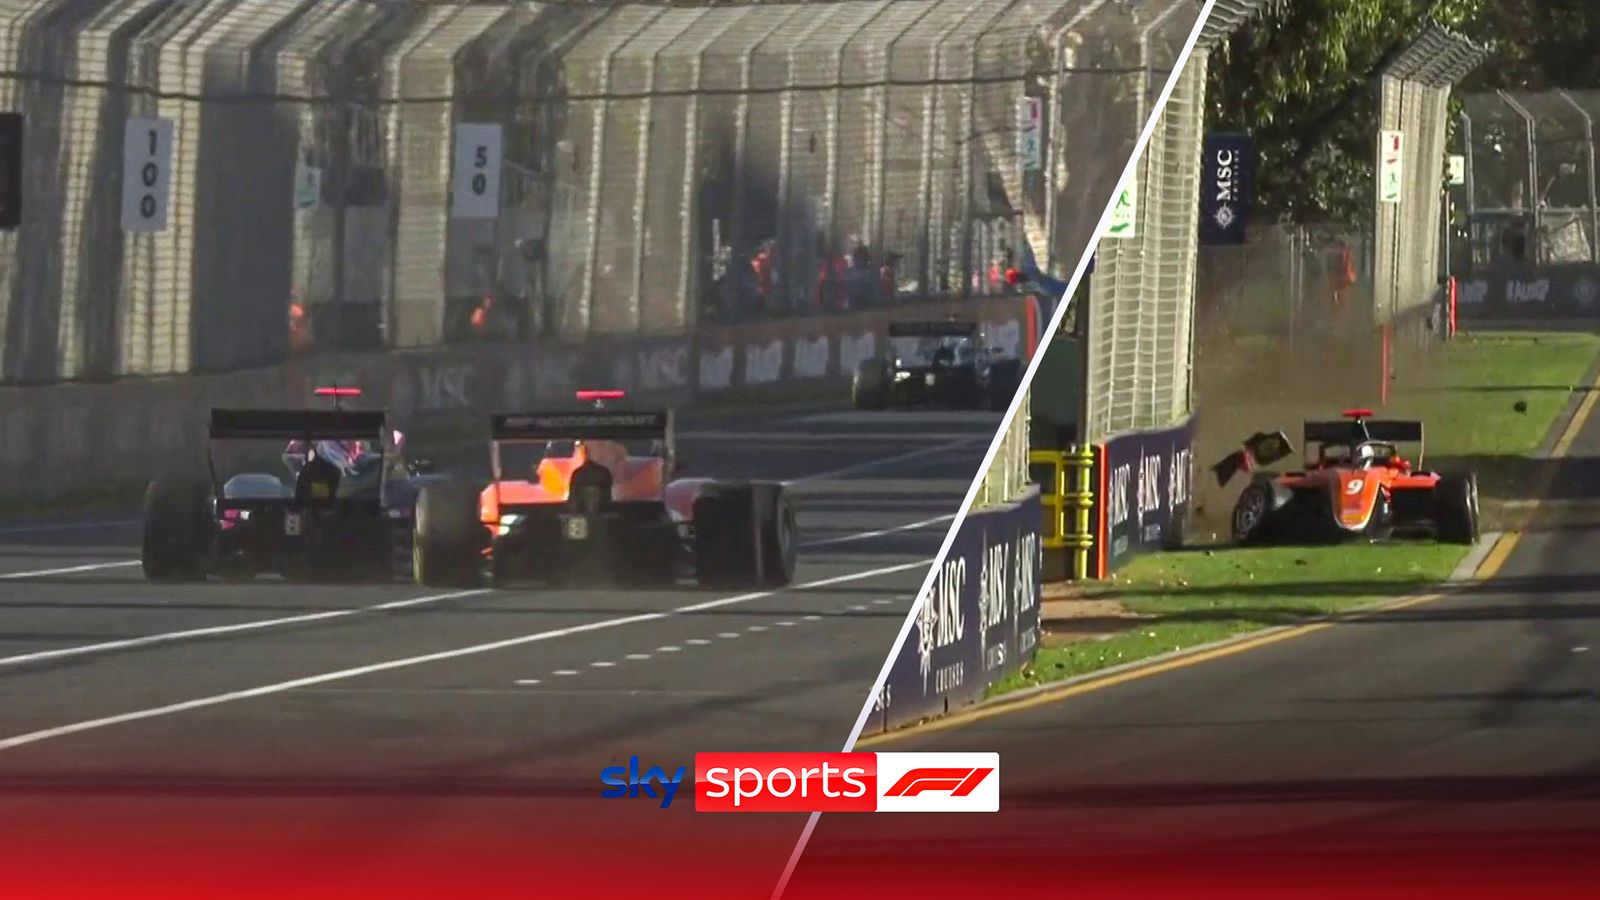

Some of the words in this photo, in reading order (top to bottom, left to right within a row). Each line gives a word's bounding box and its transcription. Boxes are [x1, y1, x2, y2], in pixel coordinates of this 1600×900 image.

[141, 129, 159, 219] 100
[473, 146, 487, 196] 50
[1217, 150, 1232, 200] MSC
[1345, 479, 1364, 495] 9
[937, 556, 966, 647] MSC
[988, 542, 1009, 626] MSC
